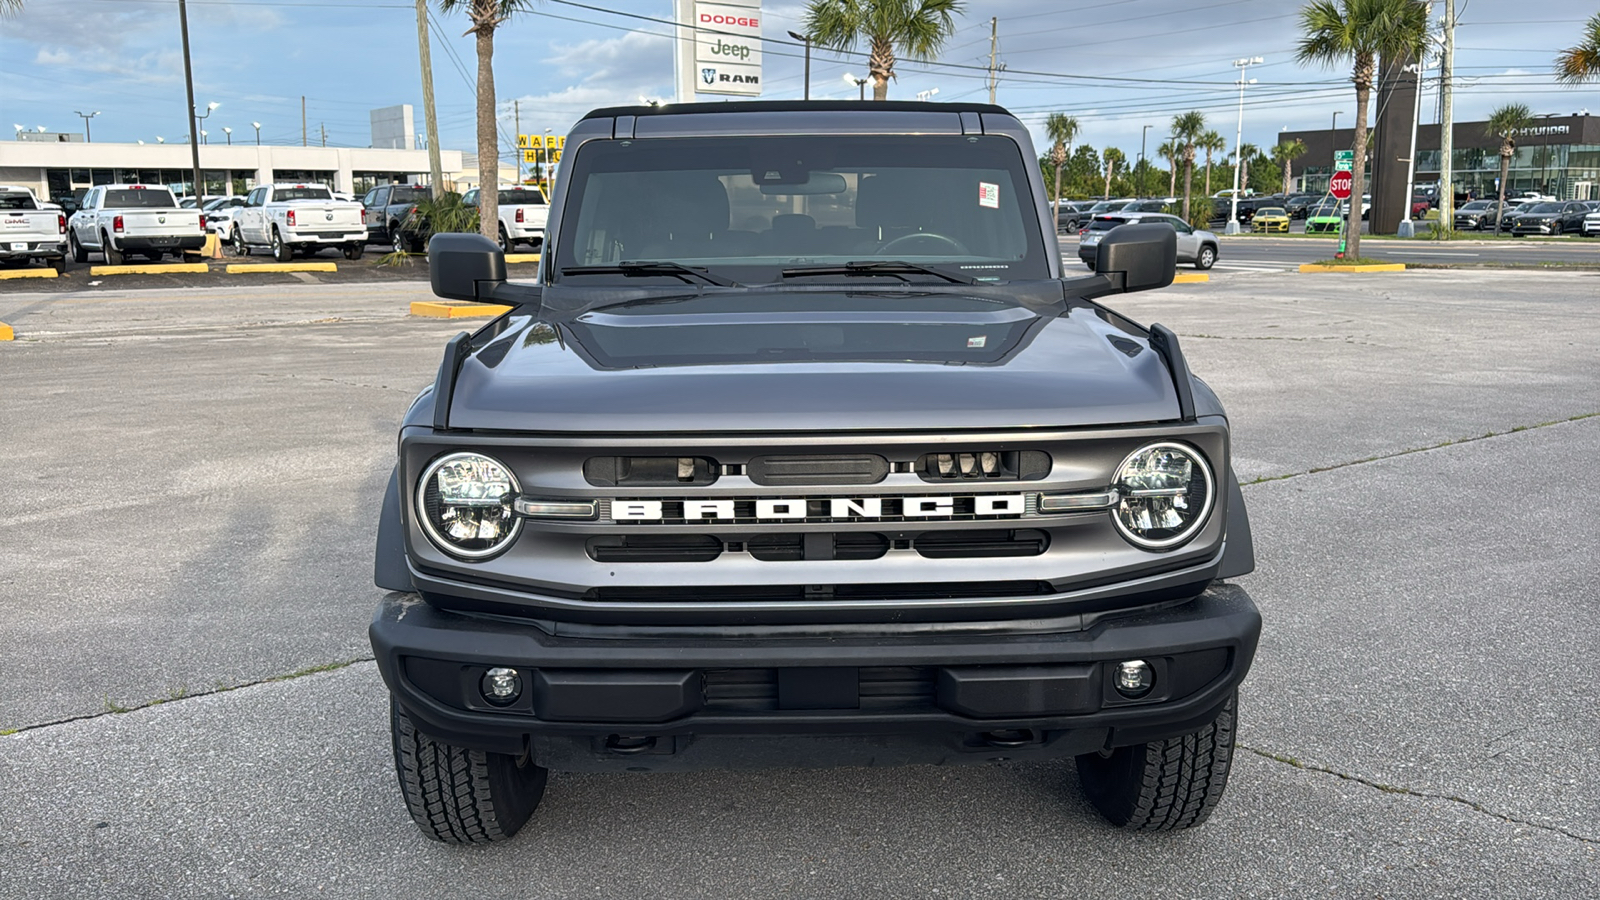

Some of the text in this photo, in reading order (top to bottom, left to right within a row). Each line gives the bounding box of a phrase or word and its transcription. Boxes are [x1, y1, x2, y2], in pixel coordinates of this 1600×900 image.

[700, 14, 759, 27] DODGE
[711, 39, 750, 60] Jeep
[719, 74, 759, 84] RAM
[1520, 125, 1569, 136] HYUNDAI
[519, 136, 565, 147] WAFF
[611, 495, 1025, 519] BRONCO
